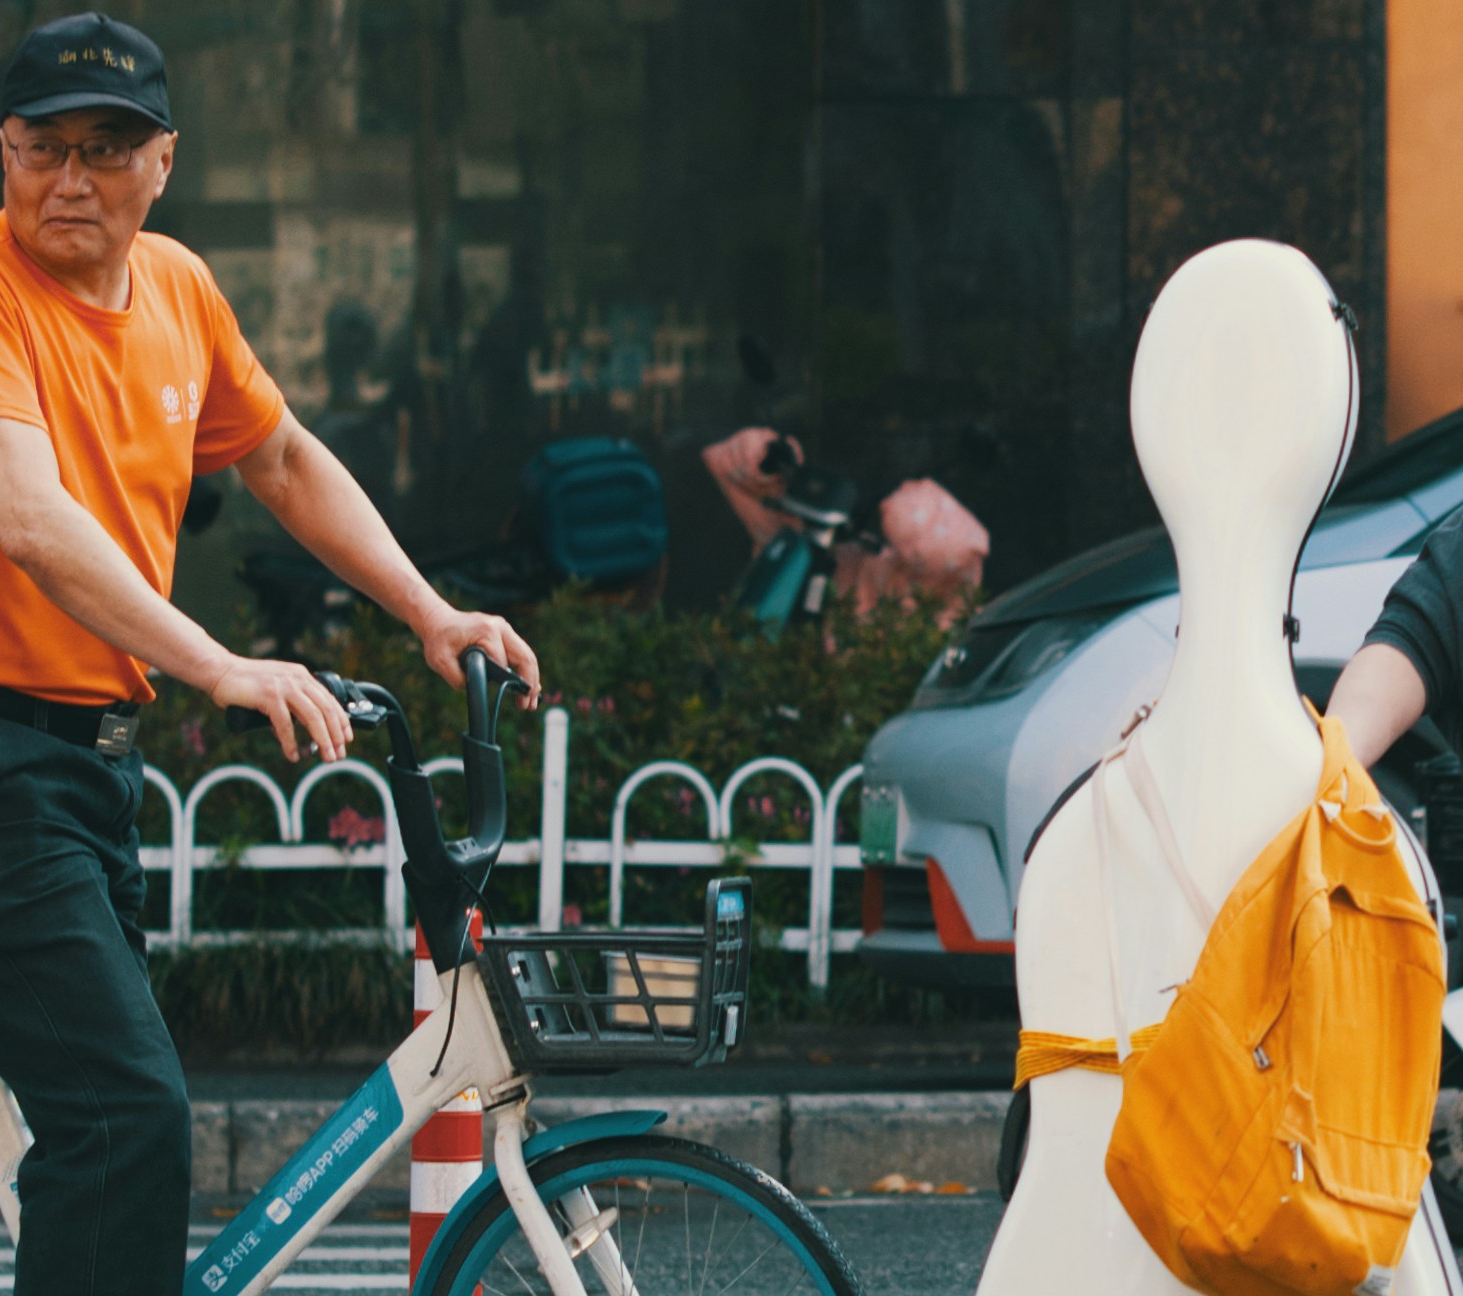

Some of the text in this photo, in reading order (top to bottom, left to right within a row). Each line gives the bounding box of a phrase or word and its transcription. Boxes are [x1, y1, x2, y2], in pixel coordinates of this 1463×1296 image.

[221, 1230, 261, 1274] 支付宝
[332, 1105, 379, 1157] 扫码骑车
